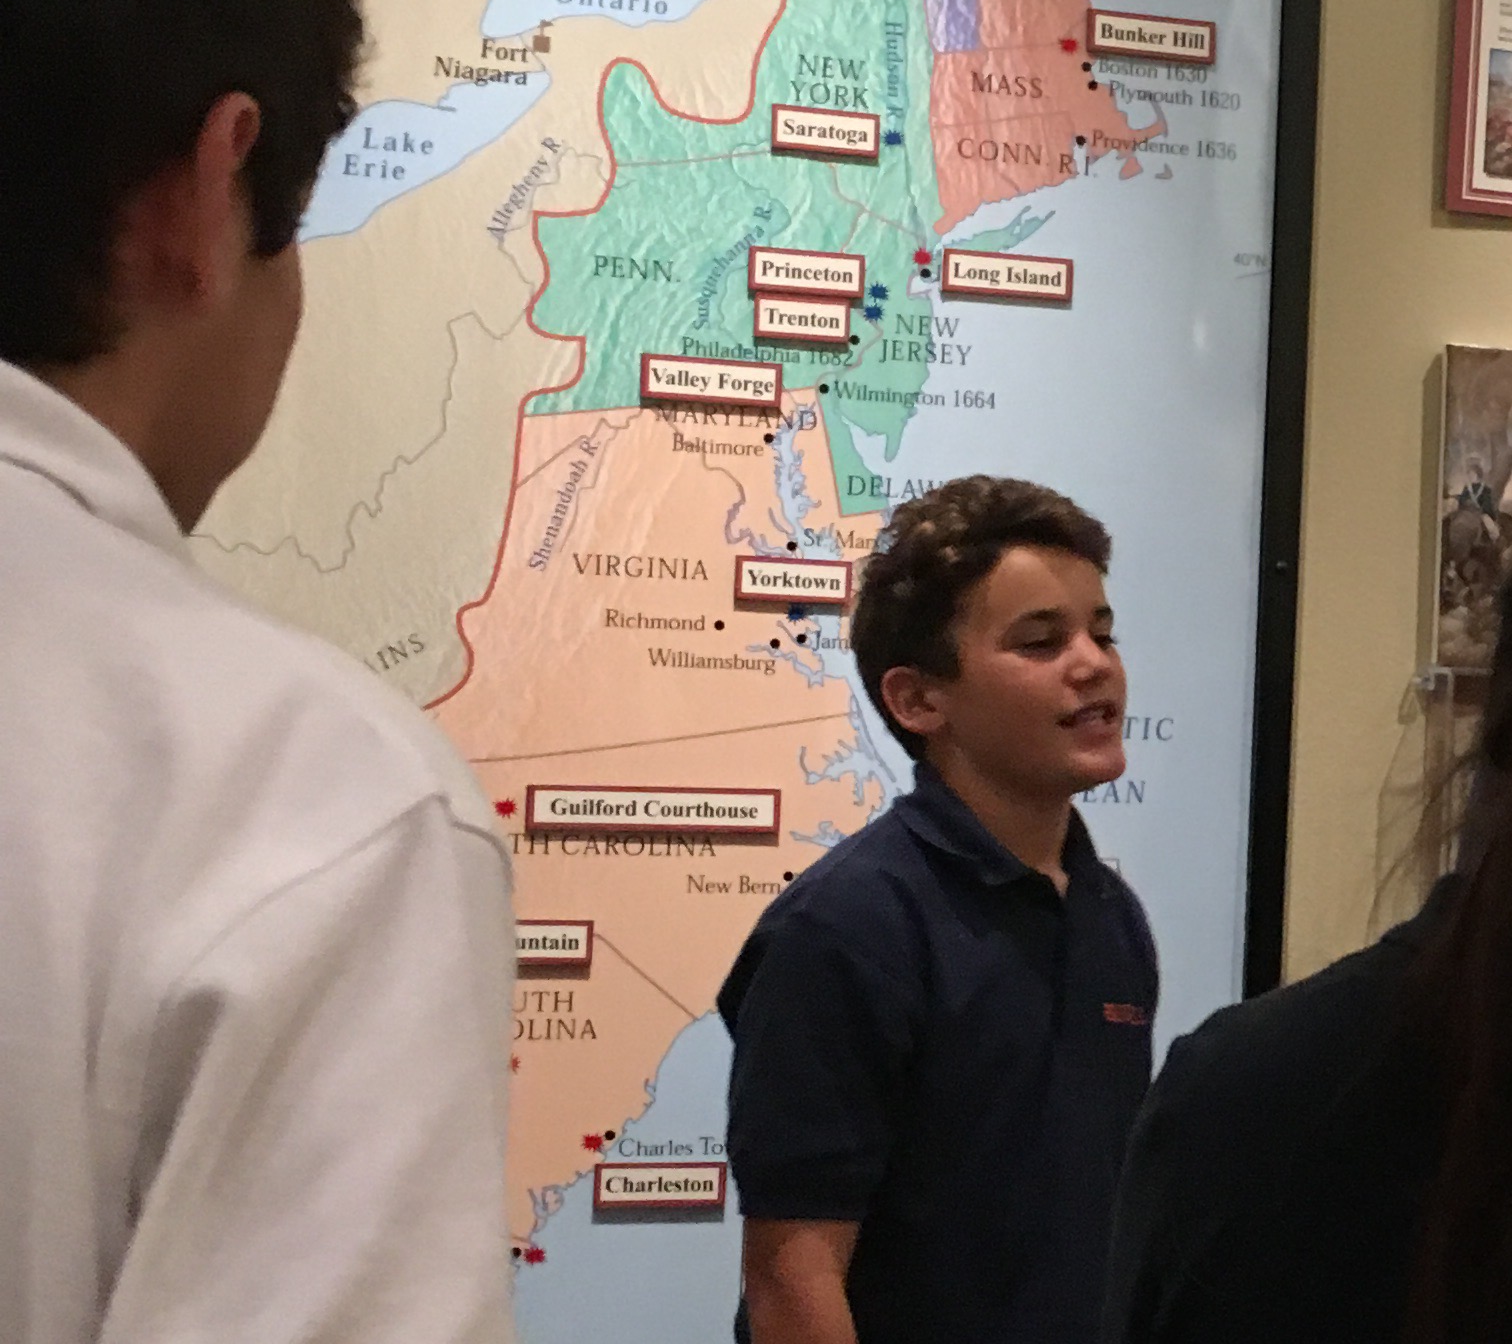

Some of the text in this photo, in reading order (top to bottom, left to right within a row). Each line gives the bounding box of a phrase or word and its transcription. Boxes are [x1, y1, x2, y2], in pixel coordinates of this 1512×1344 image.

[1101, 22, 1206, 51] Bunker Hill
[480, 38, 529, 63] Fort
[884, 21, 904, 98] Hudson
[433, 55, 528, 86] Niagara
[798, 54, 867, 81] NEW
[1098, 58, 1208, 85] Boston 1630
[790, 80, 869, 108] YORK
[1109, 79, 1242, 111] Plymouth 1620
[363, 127, 434, 154] Lake
[782, 118, 868, 145] Saratoga
[1092, 128, 1238, 161] Providence 1636
[342, 153, 407, 181] Erie
[486, 156, 549, 243] Allegheny
[593, 255, 681, 283] PENN.
[761, 260, 854, 285] Princeton
[953, 262, 1062, 288] Long Island
[764, 307, 841, 331] Trenton
[895, 313, 961, 339] NEW
[681, 336, 854, 367] Philadelphia 1682
[878, 339, 973, 367] JERSEY
[651, 367, 775, 397] Valley Forge
[833, 380, 997, 410] Wilmington 1664
[655, 407, 818, 431] MARYLAND
[672, 432, 765, 457] Baltimore
[528, 460, 588, 572] Shenandoah
[572, 553, 710, 582] VIRGINIA
[747, 569, 842, 592] Yorktown
[605, 607, 706, 632] Richmond
[647, 647, 776, 676] Williamsburg
[1123, 716, 1175, 742] TIC
[550, 797, 758, 820] Guilford Courthouse
[561, 833, 717, 857] CAROLINA
[686, 873, 731, 894] New
[515, 933, 580, 952] untain
[618, 1137, 693, 1157] Charles
[604, 1174, 716, 1195] Charleston
